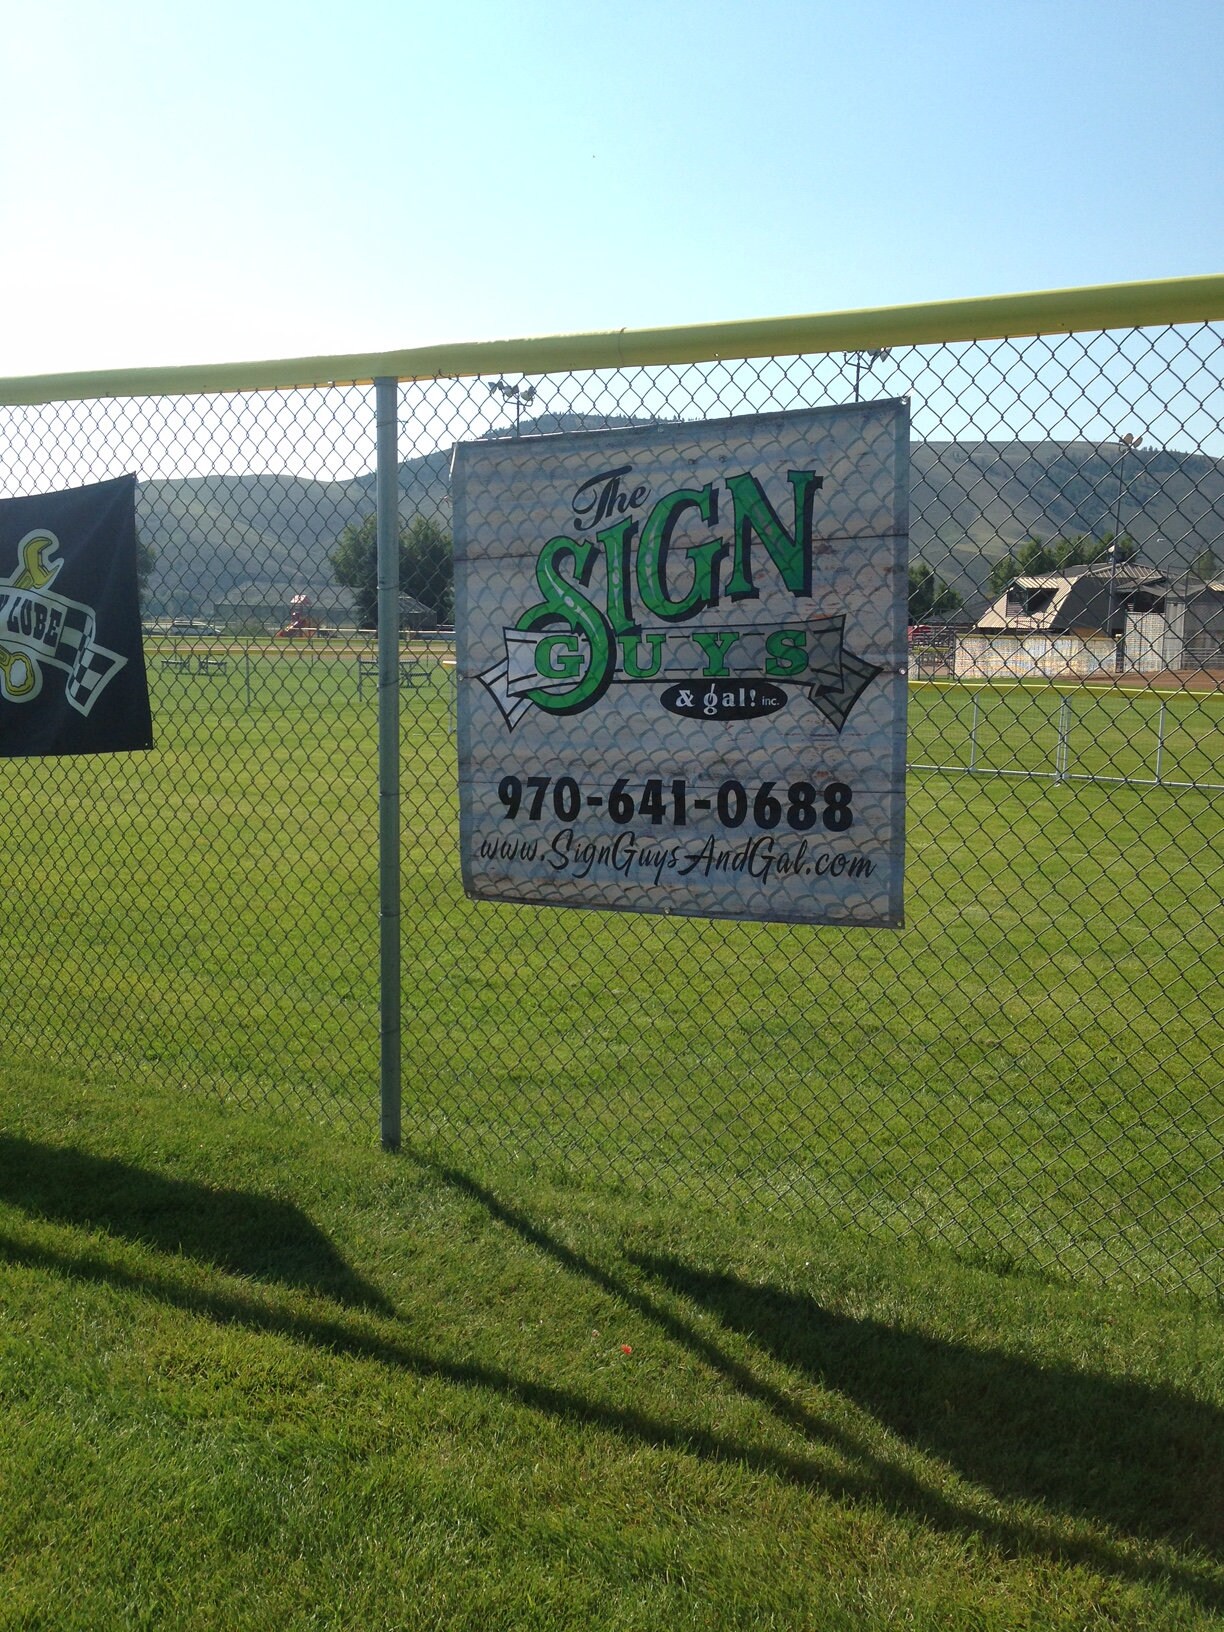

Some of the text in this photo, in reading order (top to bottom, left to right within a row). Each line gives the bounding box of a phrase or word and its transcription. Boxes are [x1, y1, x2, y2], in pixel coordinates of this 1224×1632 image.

[572, 465, 650, 531] The
[7, 595, 63, 648] LUBE
[515, 469, 824, 717] SIGN
[534, 628, 809, 681] GUYS
[675, 690, 695, 708] &
[703, 683, 757, 715] gal!
[498, 775, 854, 832] 970-641-0688
[480, 828, 877, 885] www.SignGuysAndGal.com
